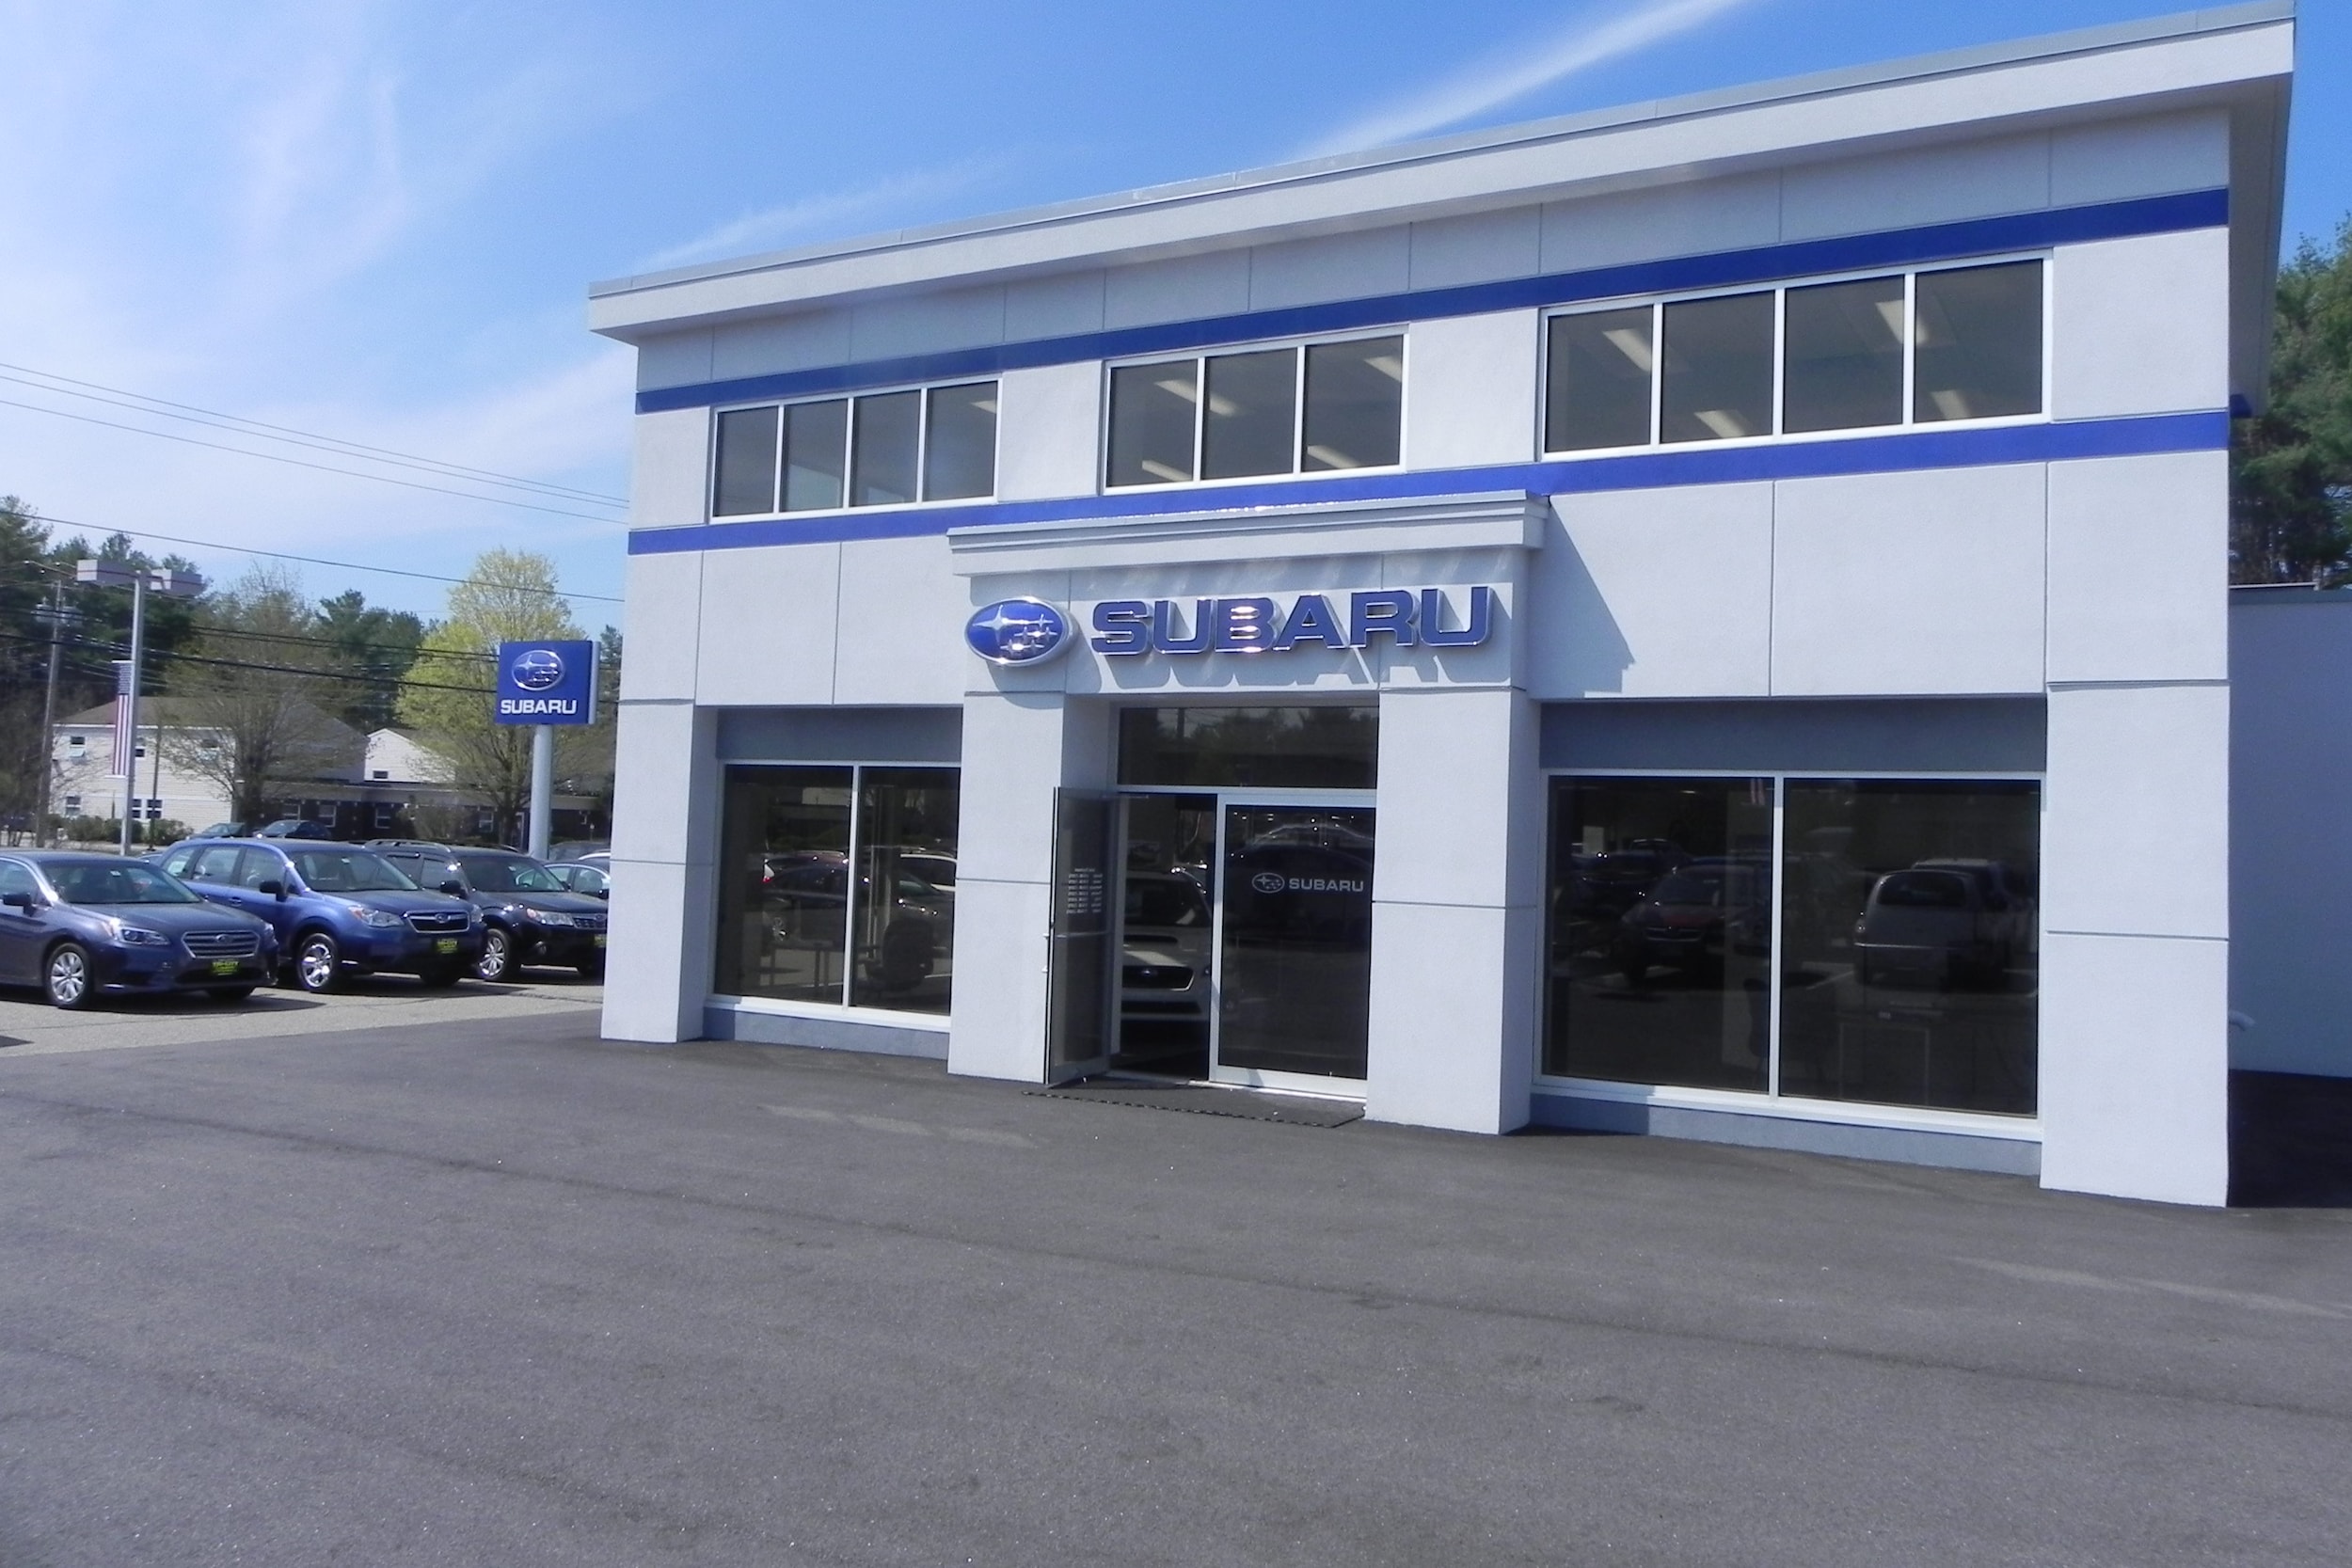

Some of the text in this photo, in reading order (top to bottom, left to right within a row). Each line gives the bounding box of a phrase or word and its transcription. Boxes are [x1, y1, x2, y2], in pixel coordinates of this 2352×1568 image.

[1091, 586, 1491, 655] SUBARU
[501, 699, 577, 714] SUBARU
[1288, 878, 1364, 893] SUBARU
